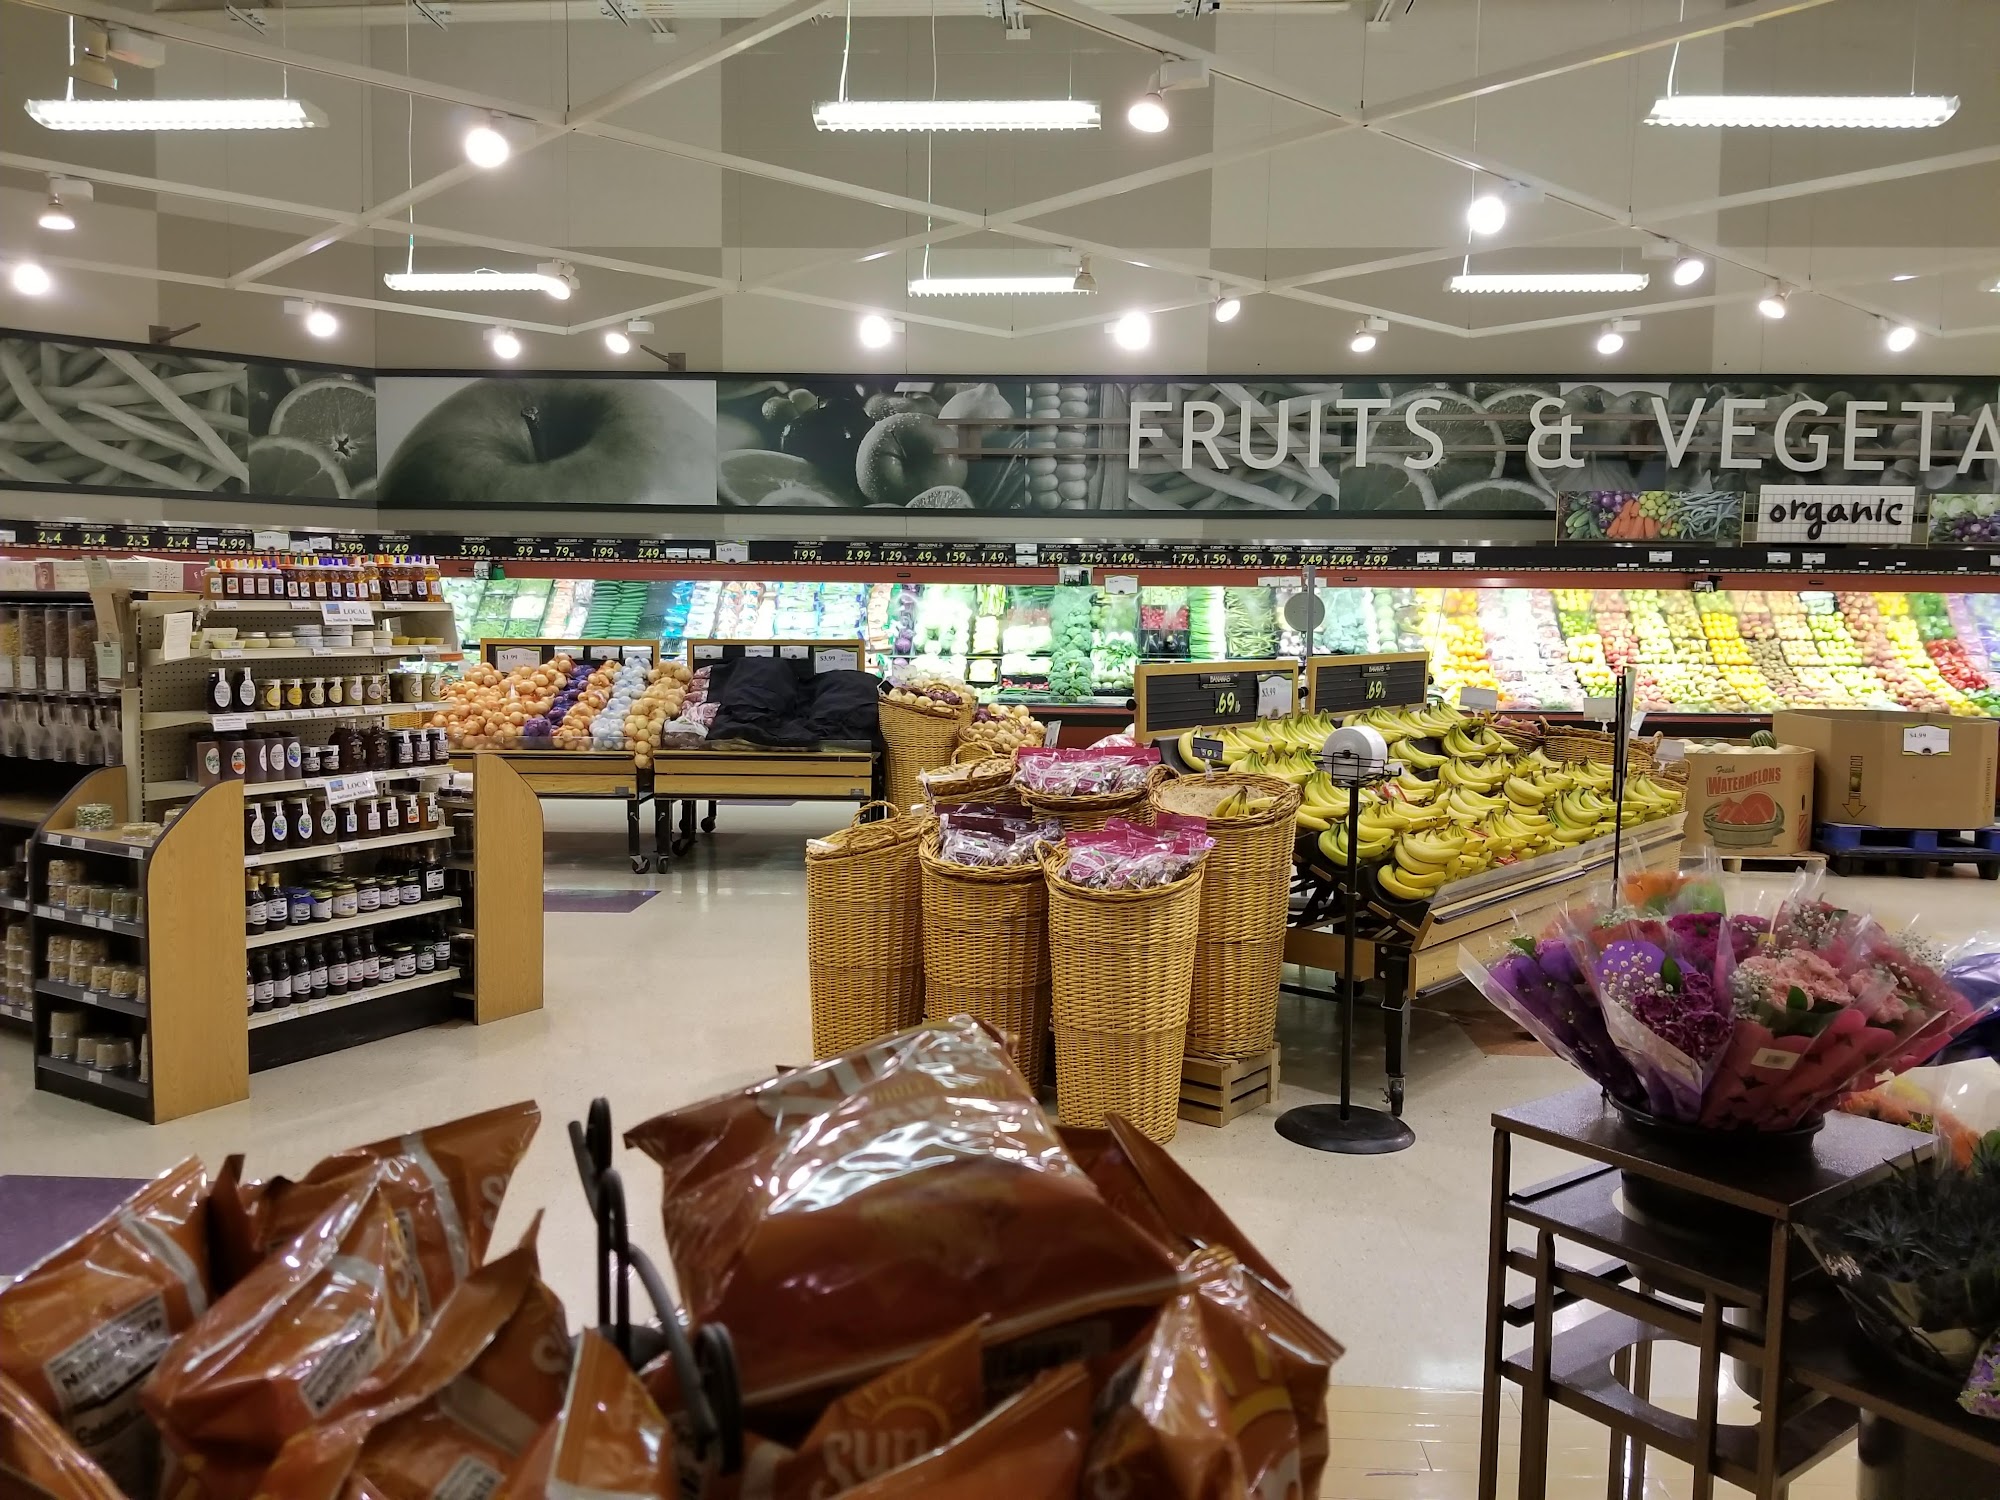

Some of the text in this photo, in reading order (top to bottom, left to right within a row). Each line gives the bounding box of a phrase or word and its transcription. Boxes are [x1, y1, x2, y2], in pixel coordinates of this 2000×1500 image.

[1128, 397, 2000, 474] FRUITS & VEGETA
[1769, 498, 1904, 540] organic
[38, 531, 46, 543] 2
[54, 532, 62, 544] 4
[83, 533, 91, 545] 2
[98, 533, 106, 545] 4
[127, 535, 134, 547] 2
[141, 535, 149, 547] 3
[166, 536, 174, 547] 2
[181, 536, 190, 547] 4
[219, 538, 246, 550] 4.99
[460, 545, 486, 556] 3.99
[592, 547, 614, 558] 1.99
[638, 548, 659, 558] 2.49
[793, 550, 817, 561] 1.99
[846, 550, 871, 561] 2.99
[880, 551, 902, 561] 1.29
[1040, 552, 1063, 563] 1.49
[1080, 553, 1103, 563] 2.19
[1112, 553, 1135, 564] 1.49
[1172, 554, 1195, 564] 1.79
[1204, 554, 1227, 564] 1.59
[1299, 555, 1323, 565] 2.49
[1330, 555, 1354, 565] 2.49
[1364, 555, 1389, 566] 2.99
[1209, 675, 1231, 683] BANANAS
[1366, 680, 1382, 700] .69
[1215, 691, 1235, 714] .69
[1716, 765, 1736, 776] Fresh
[1706, 767, 1782, 797] WATERMELONS
